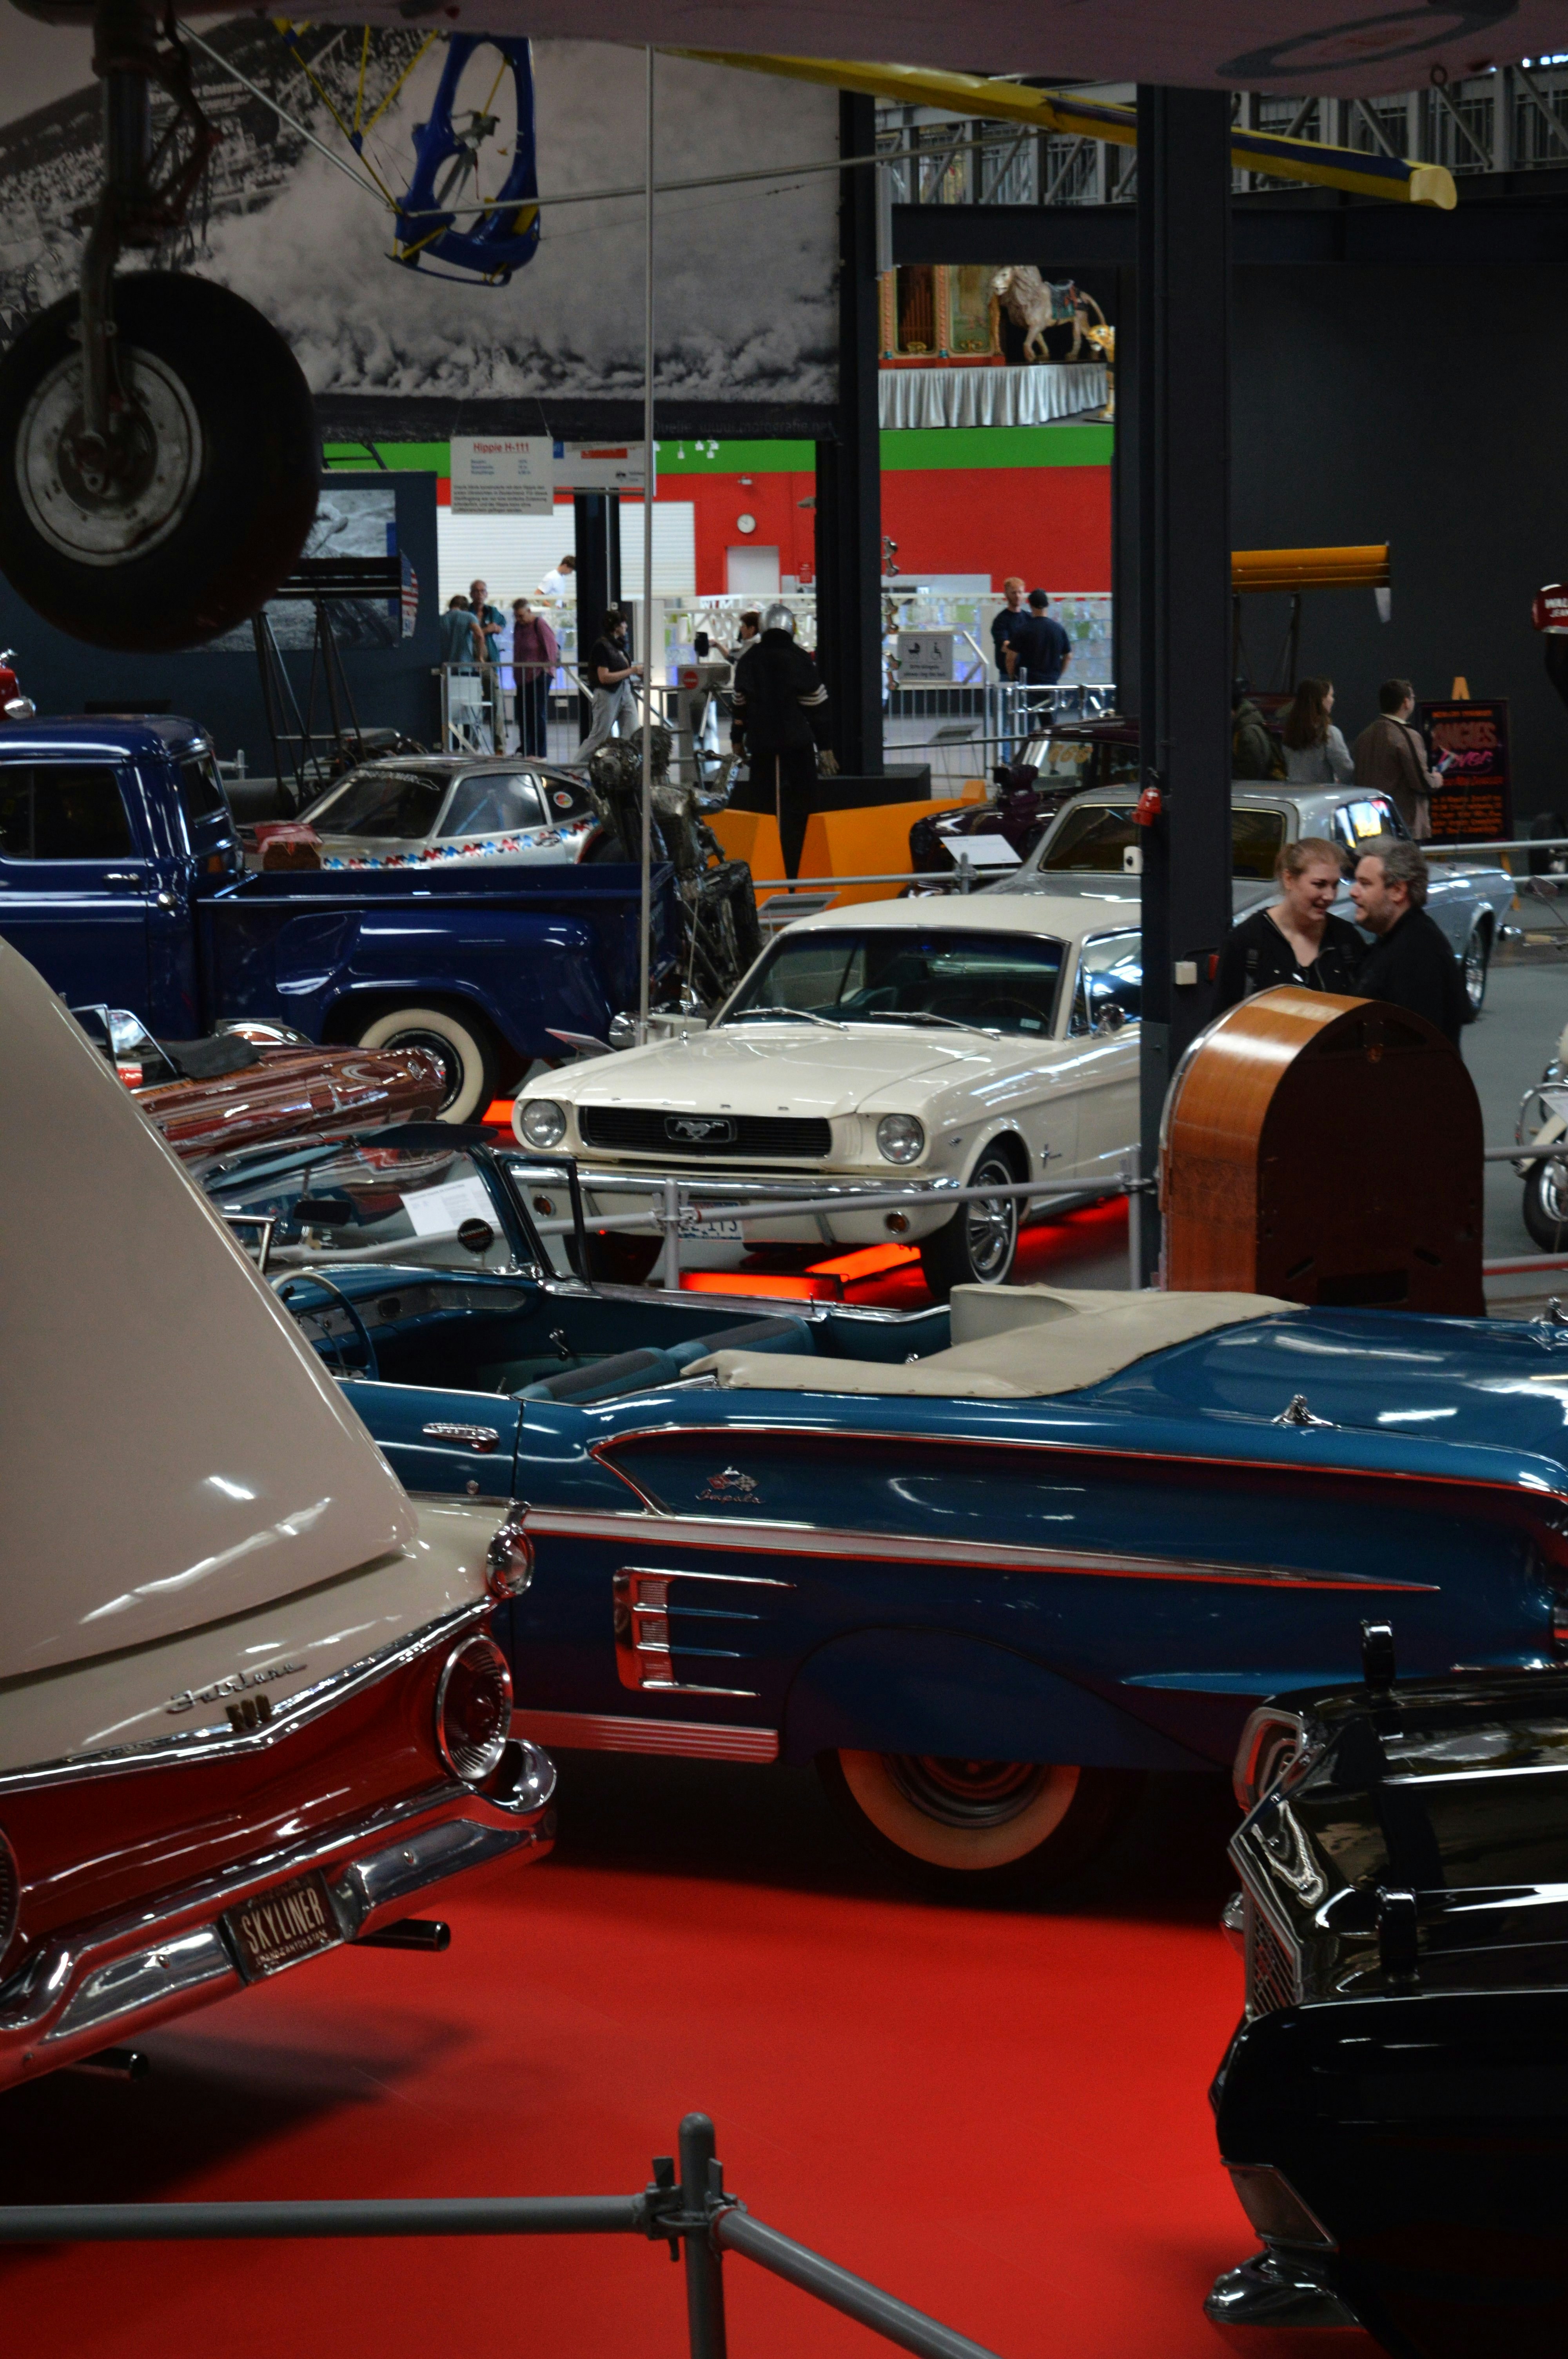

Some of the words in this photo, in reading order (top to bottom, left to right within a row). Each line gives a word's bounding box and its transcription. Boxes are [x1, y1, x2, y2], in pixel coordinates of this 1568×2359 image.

[473, 443, 502, 454] Hippie
[505, 442, 530, 453] H-111
[694, 1488, 766, 1504] Impala
[167, 1663, 307, 1714] Fairlane
[241, 1887, 325, 1954] SKYLINER
